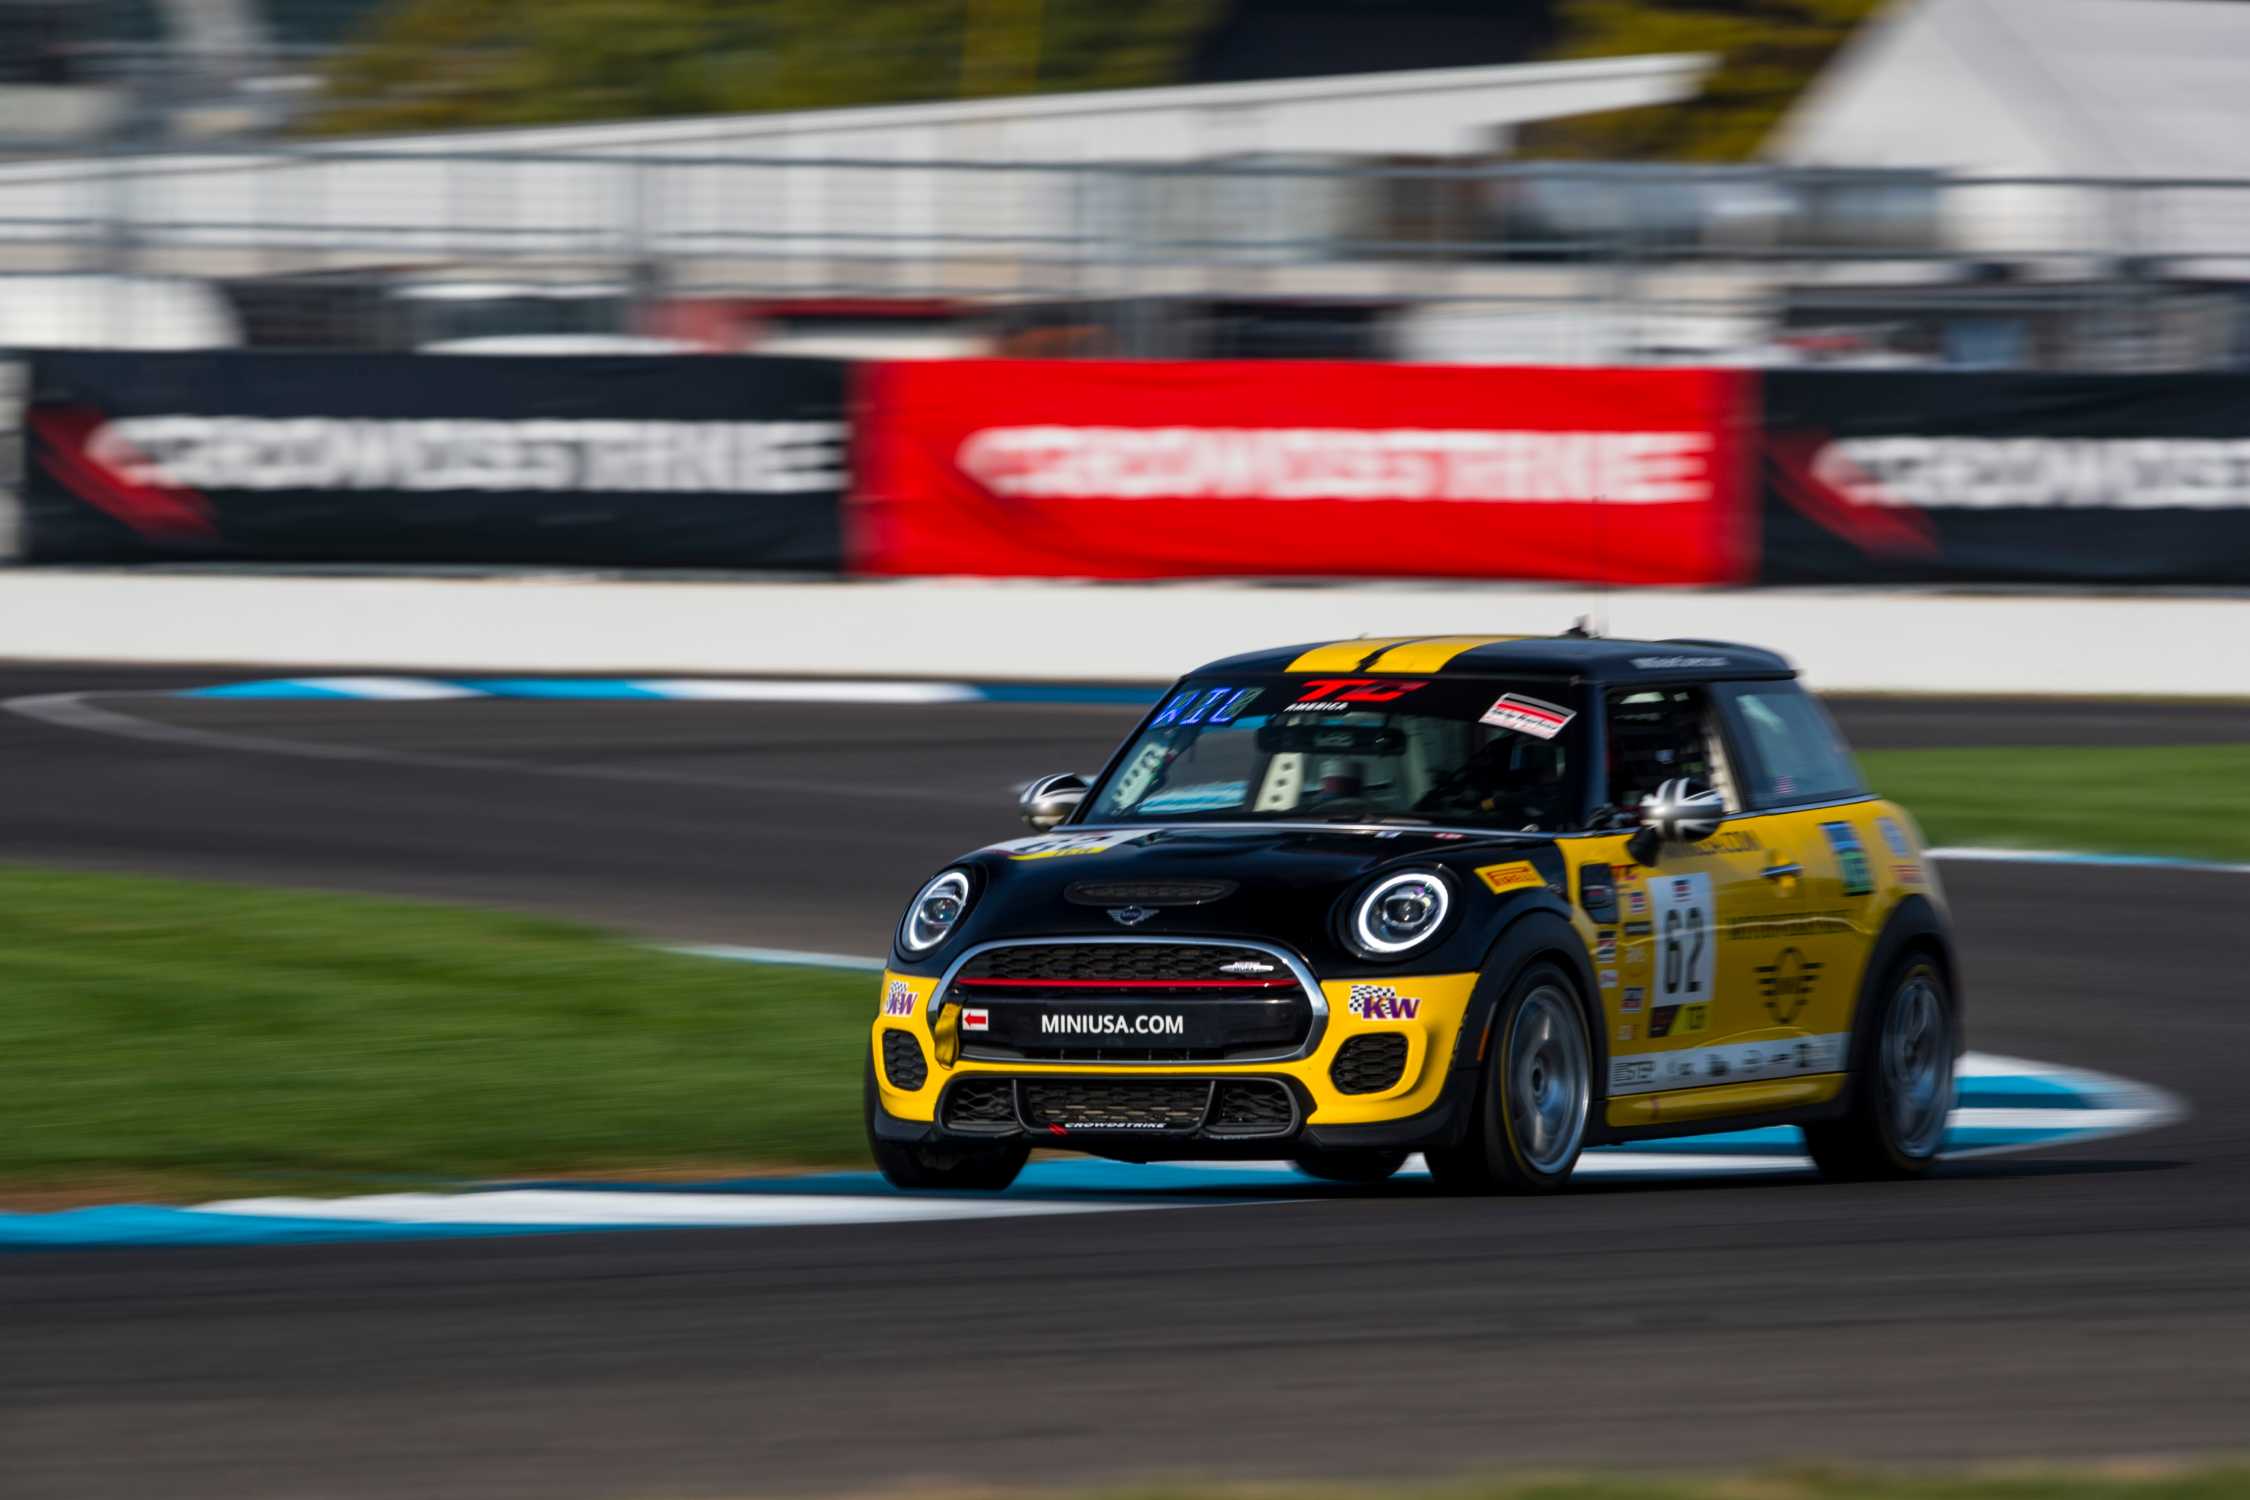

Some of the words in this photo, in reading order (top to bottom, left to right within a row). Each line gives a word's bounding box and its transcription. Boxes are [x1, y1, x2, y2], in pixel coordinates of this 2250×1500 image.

[1283, 701, 1349, 712] AMERICA
[1664, 907, 1704, 993] 62
[1363, 997, 1421, 1019] KW
[1041, 1014, 1184, 1034] MINIUSA.COM
[1064, 1121, 1168, 1129] CROWDSTRIKE
